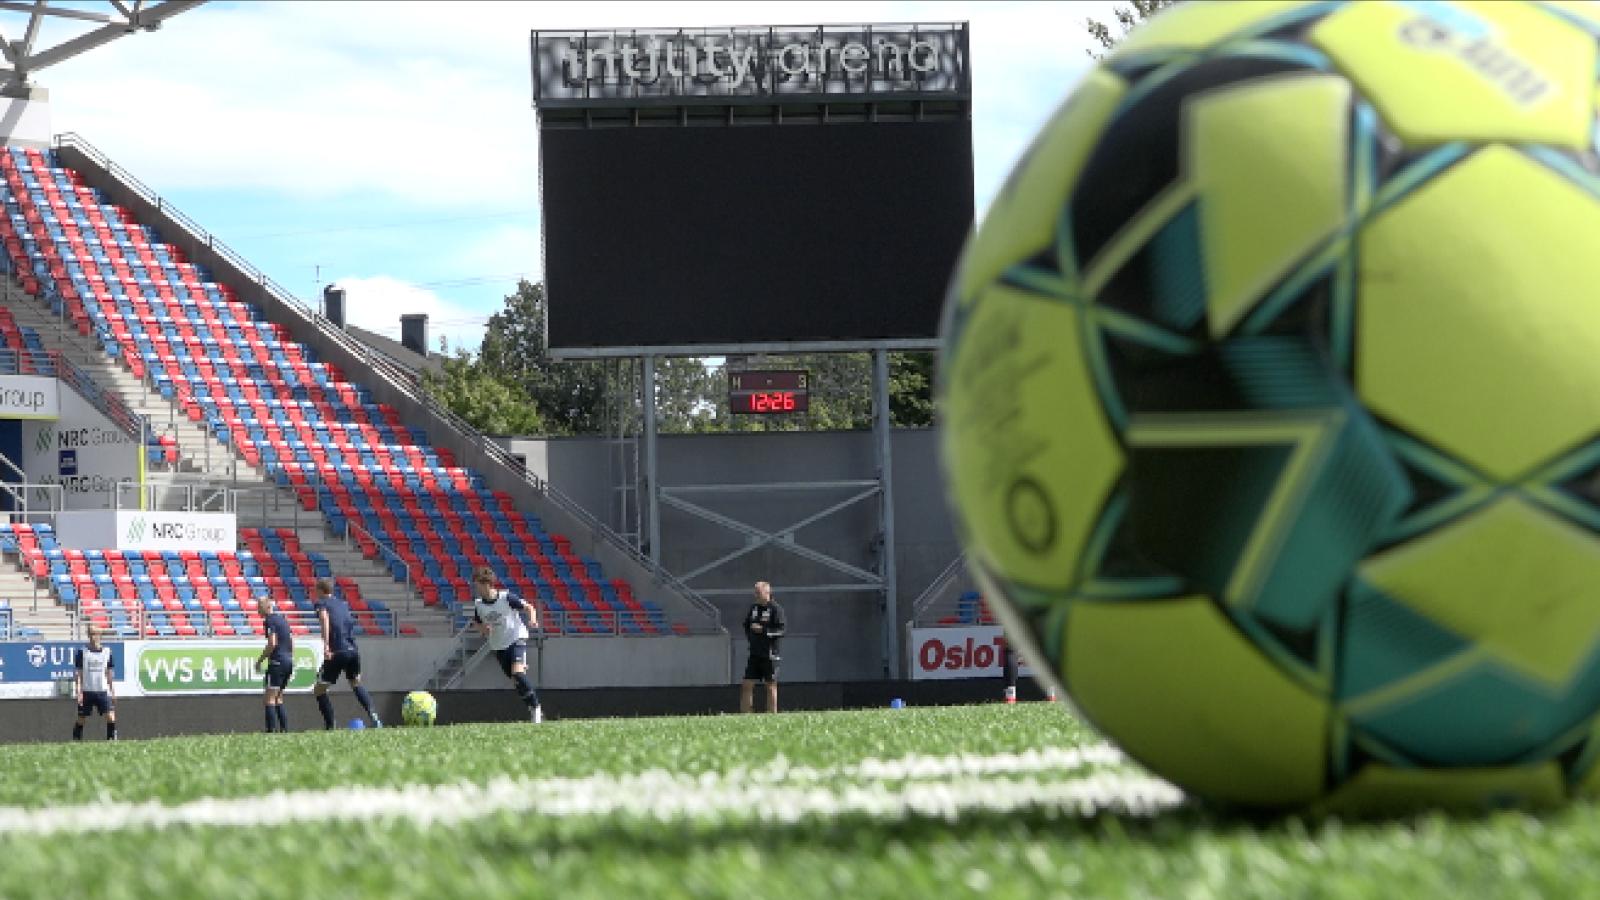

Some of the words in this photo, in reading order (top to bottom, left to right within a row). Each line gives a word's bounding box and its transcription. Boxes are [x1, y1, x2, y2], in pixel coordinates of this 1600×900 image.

[779, 40, 940, 75] arena
[749, 391, 795, 411] 12:26
[58, 428, 88, 448] NRC
[153, 522, 183, 540] NRC
[185, 522, 226, 543] Group
[919, 637, 1007, 672] OsloT
[143, 656, 194, 683] VVS
[200, 657, 218, 681] &
